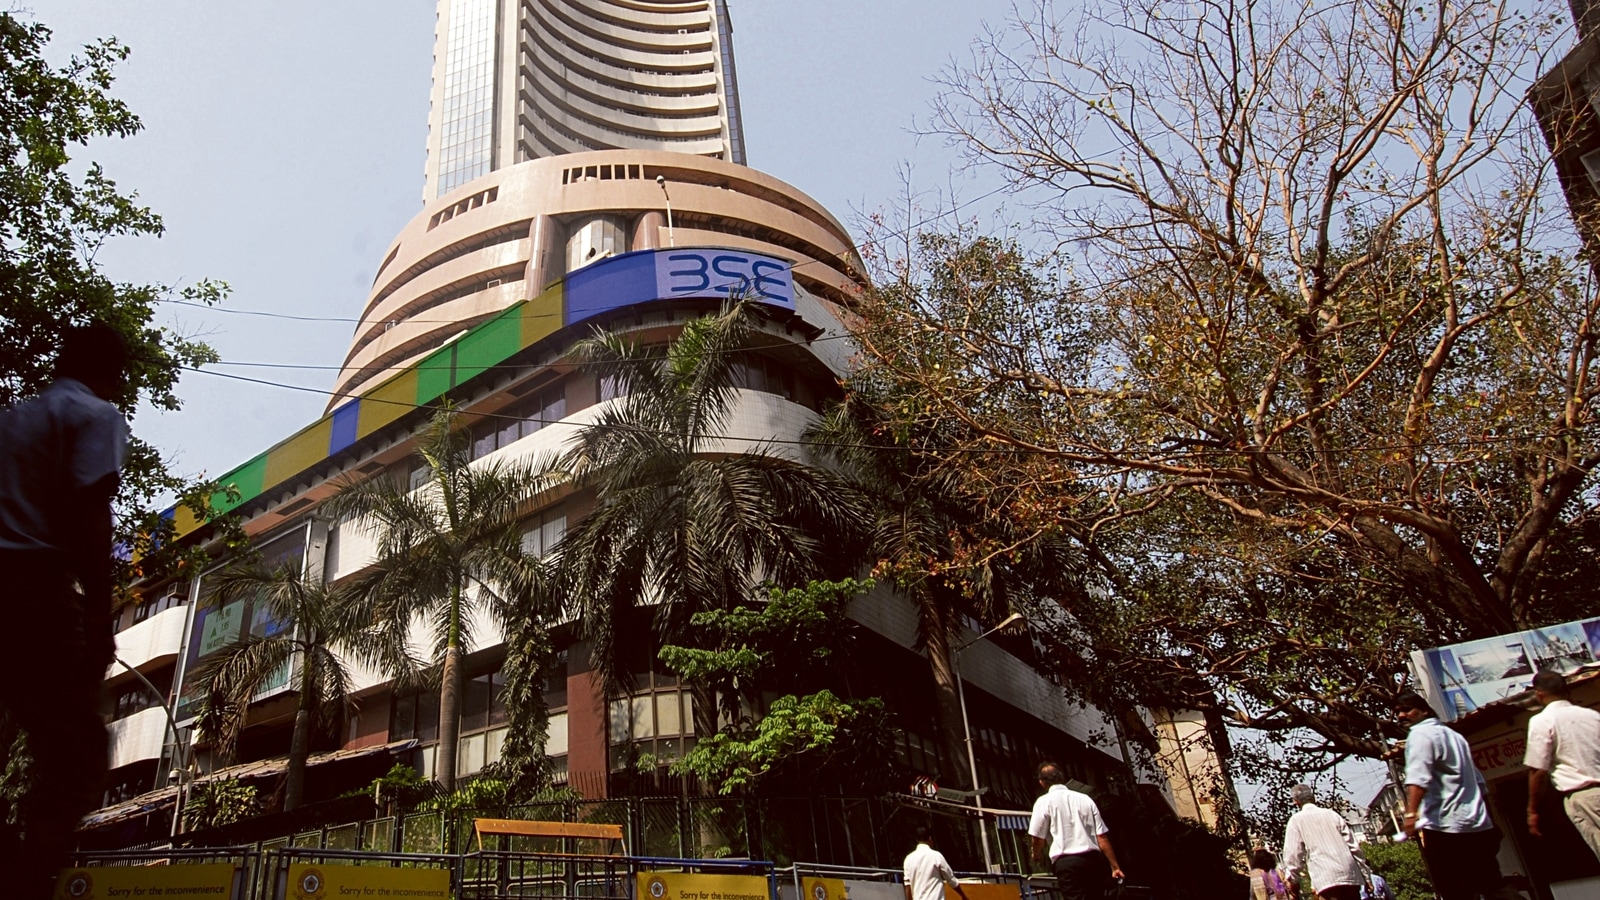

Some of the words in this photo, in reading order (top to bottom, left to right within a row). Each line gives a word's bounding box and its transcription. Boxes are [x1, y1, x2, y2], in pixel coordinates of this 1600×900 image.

[668, 254, 788, 302] BSE
[107, 886, 131, 899] Sorry
[133, 885, 146, 896] for
[149, 886, 163, 896] the
[165, 884, 225, 896] inconvenience
[339, 885, 361, 898] Sorry
[363, 885, 375, 896] for
[378, 886, 391, 896] the
[392, 887, 445, 898] inconvenience
[680, 890, 699, 900] Sorry
[699, 890, 709, 900] for
[711, 891, 722, 900] the
[723, 891, 765, 900] inconvenience
